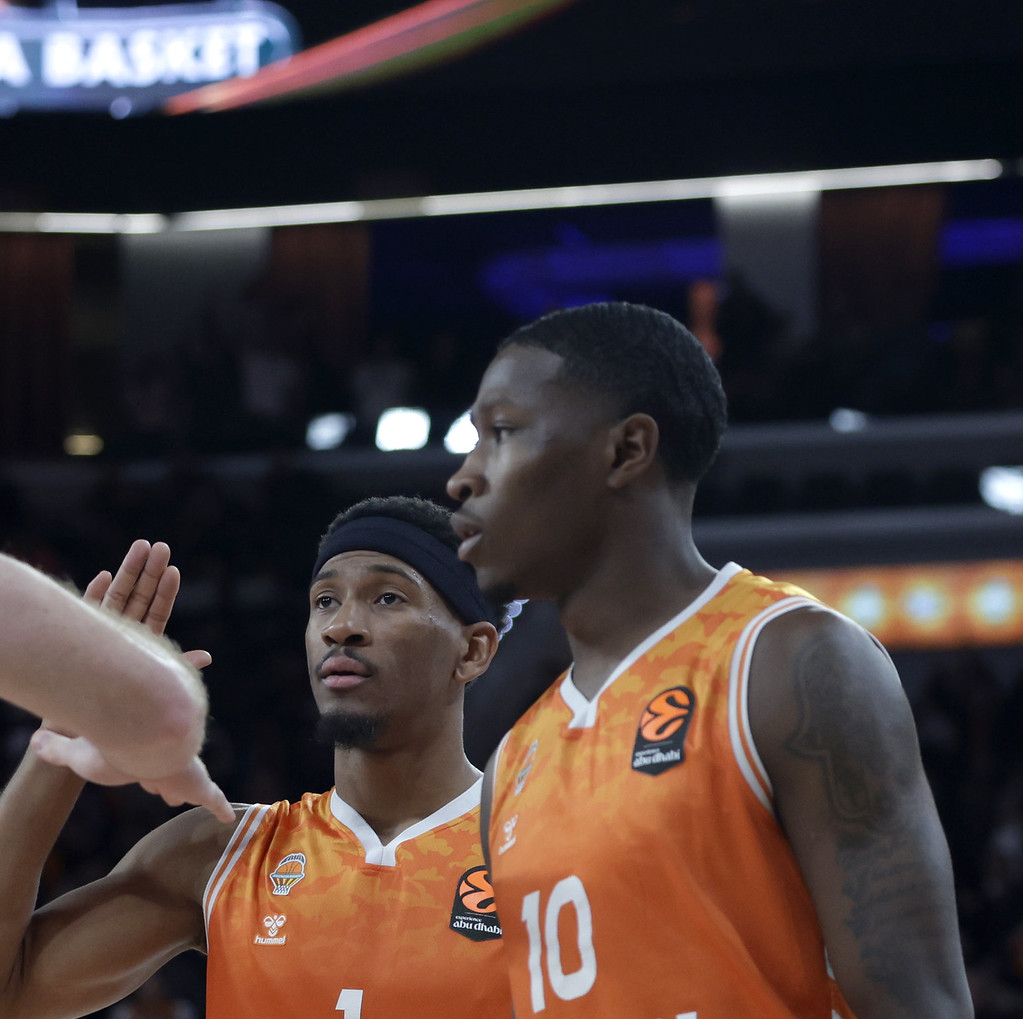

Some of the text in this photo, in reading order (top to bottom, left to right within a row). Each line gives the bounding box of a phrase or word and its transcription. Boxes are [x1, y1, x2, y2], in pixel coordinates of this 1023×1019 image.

[42, 24, 268, 88] BASKET
[254, 935, 287, 945] hummel
[452, 920, 473, 930] abu
[522, 875, 597, 1014] 10
